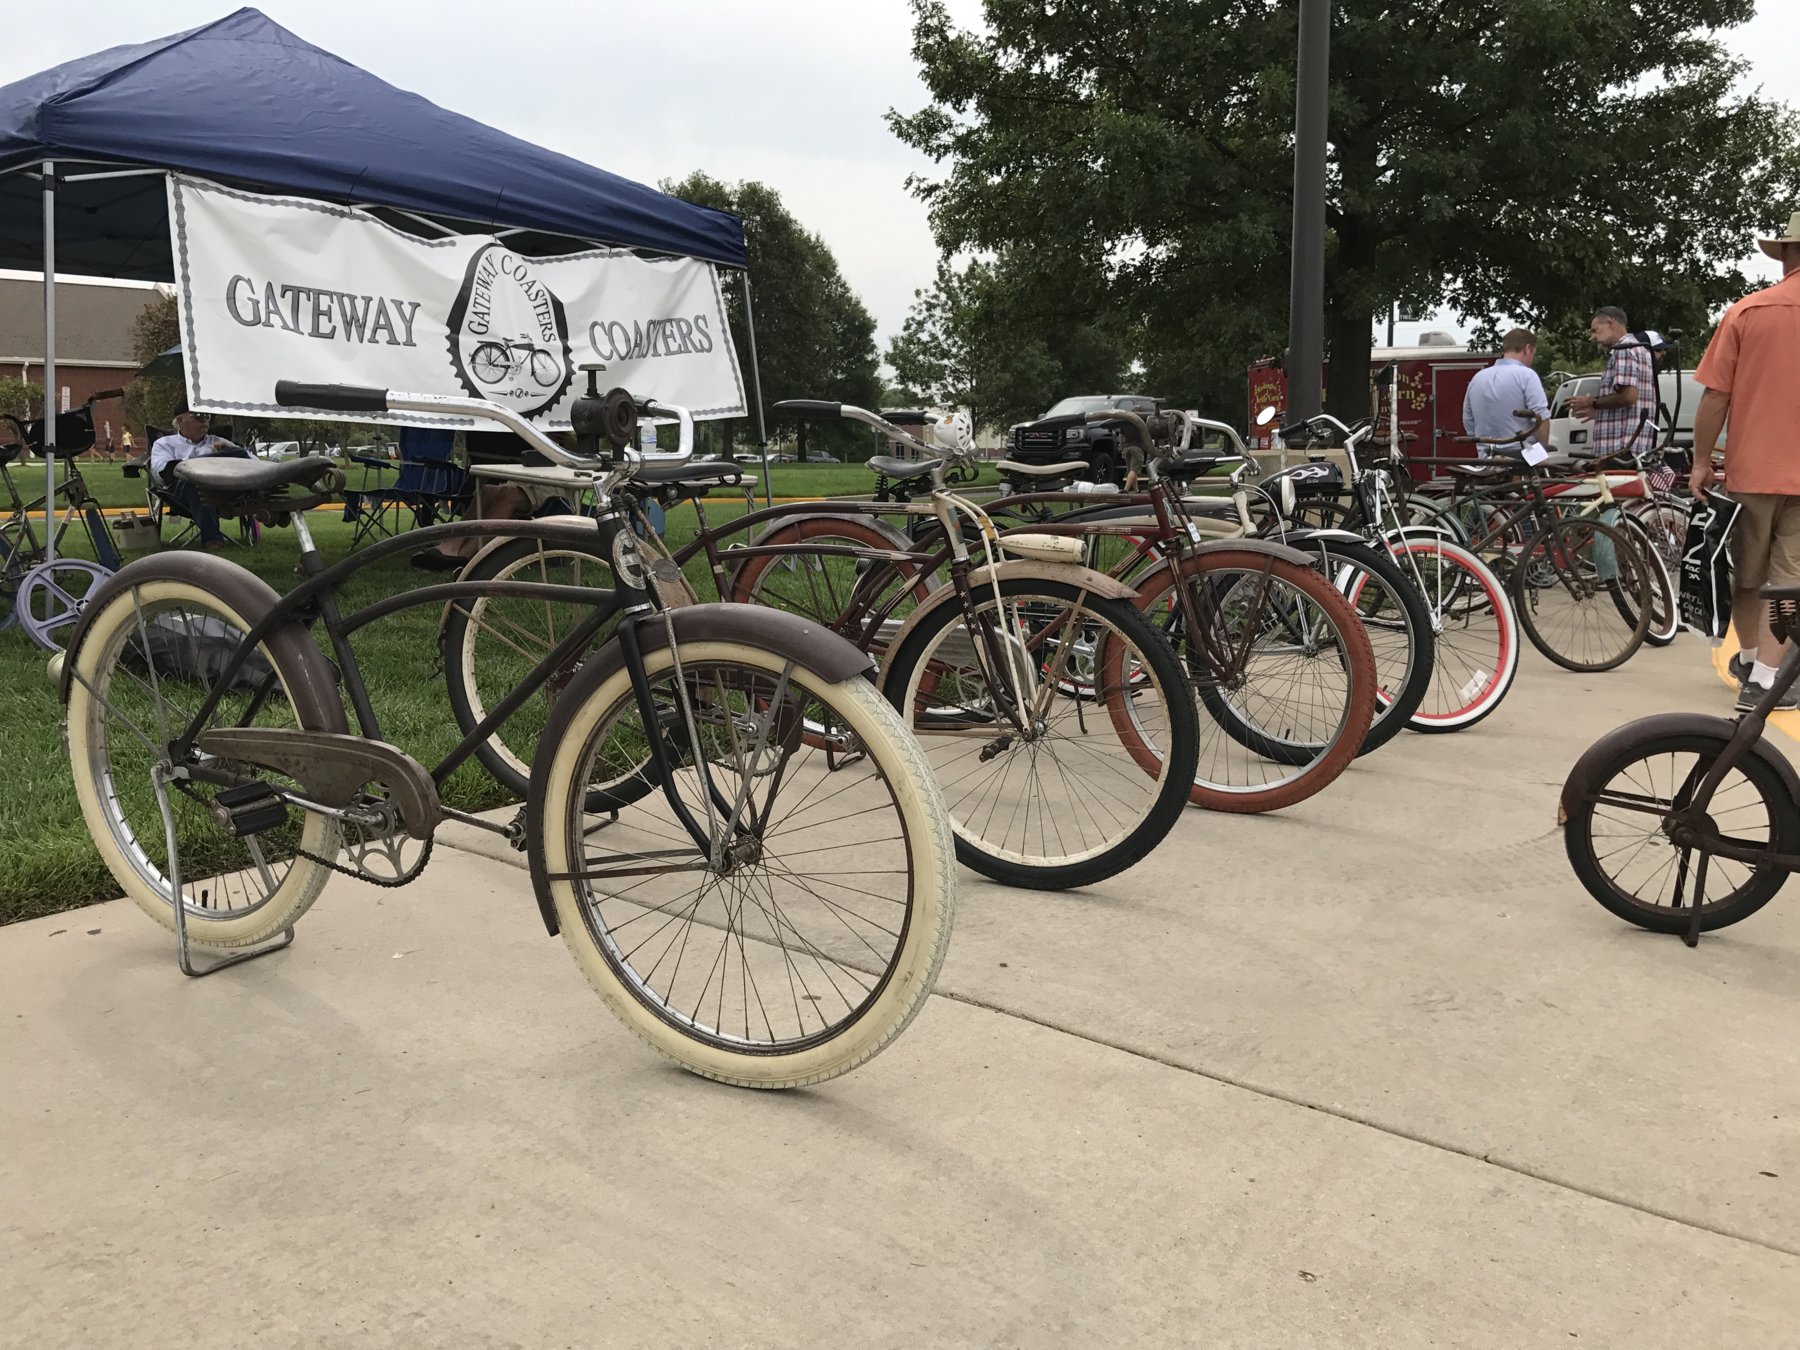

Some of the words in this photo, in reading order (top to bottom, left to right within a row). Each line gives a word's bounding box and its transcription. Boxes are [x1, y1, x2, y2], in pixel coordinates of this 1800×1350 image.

[226, 274, 421, 347] GATEWAY
[588, 313, 713, 361] COASTERS
[468, 253, 499, 335] GATEWAY
[501, 254, 557, 343] COASTERS
